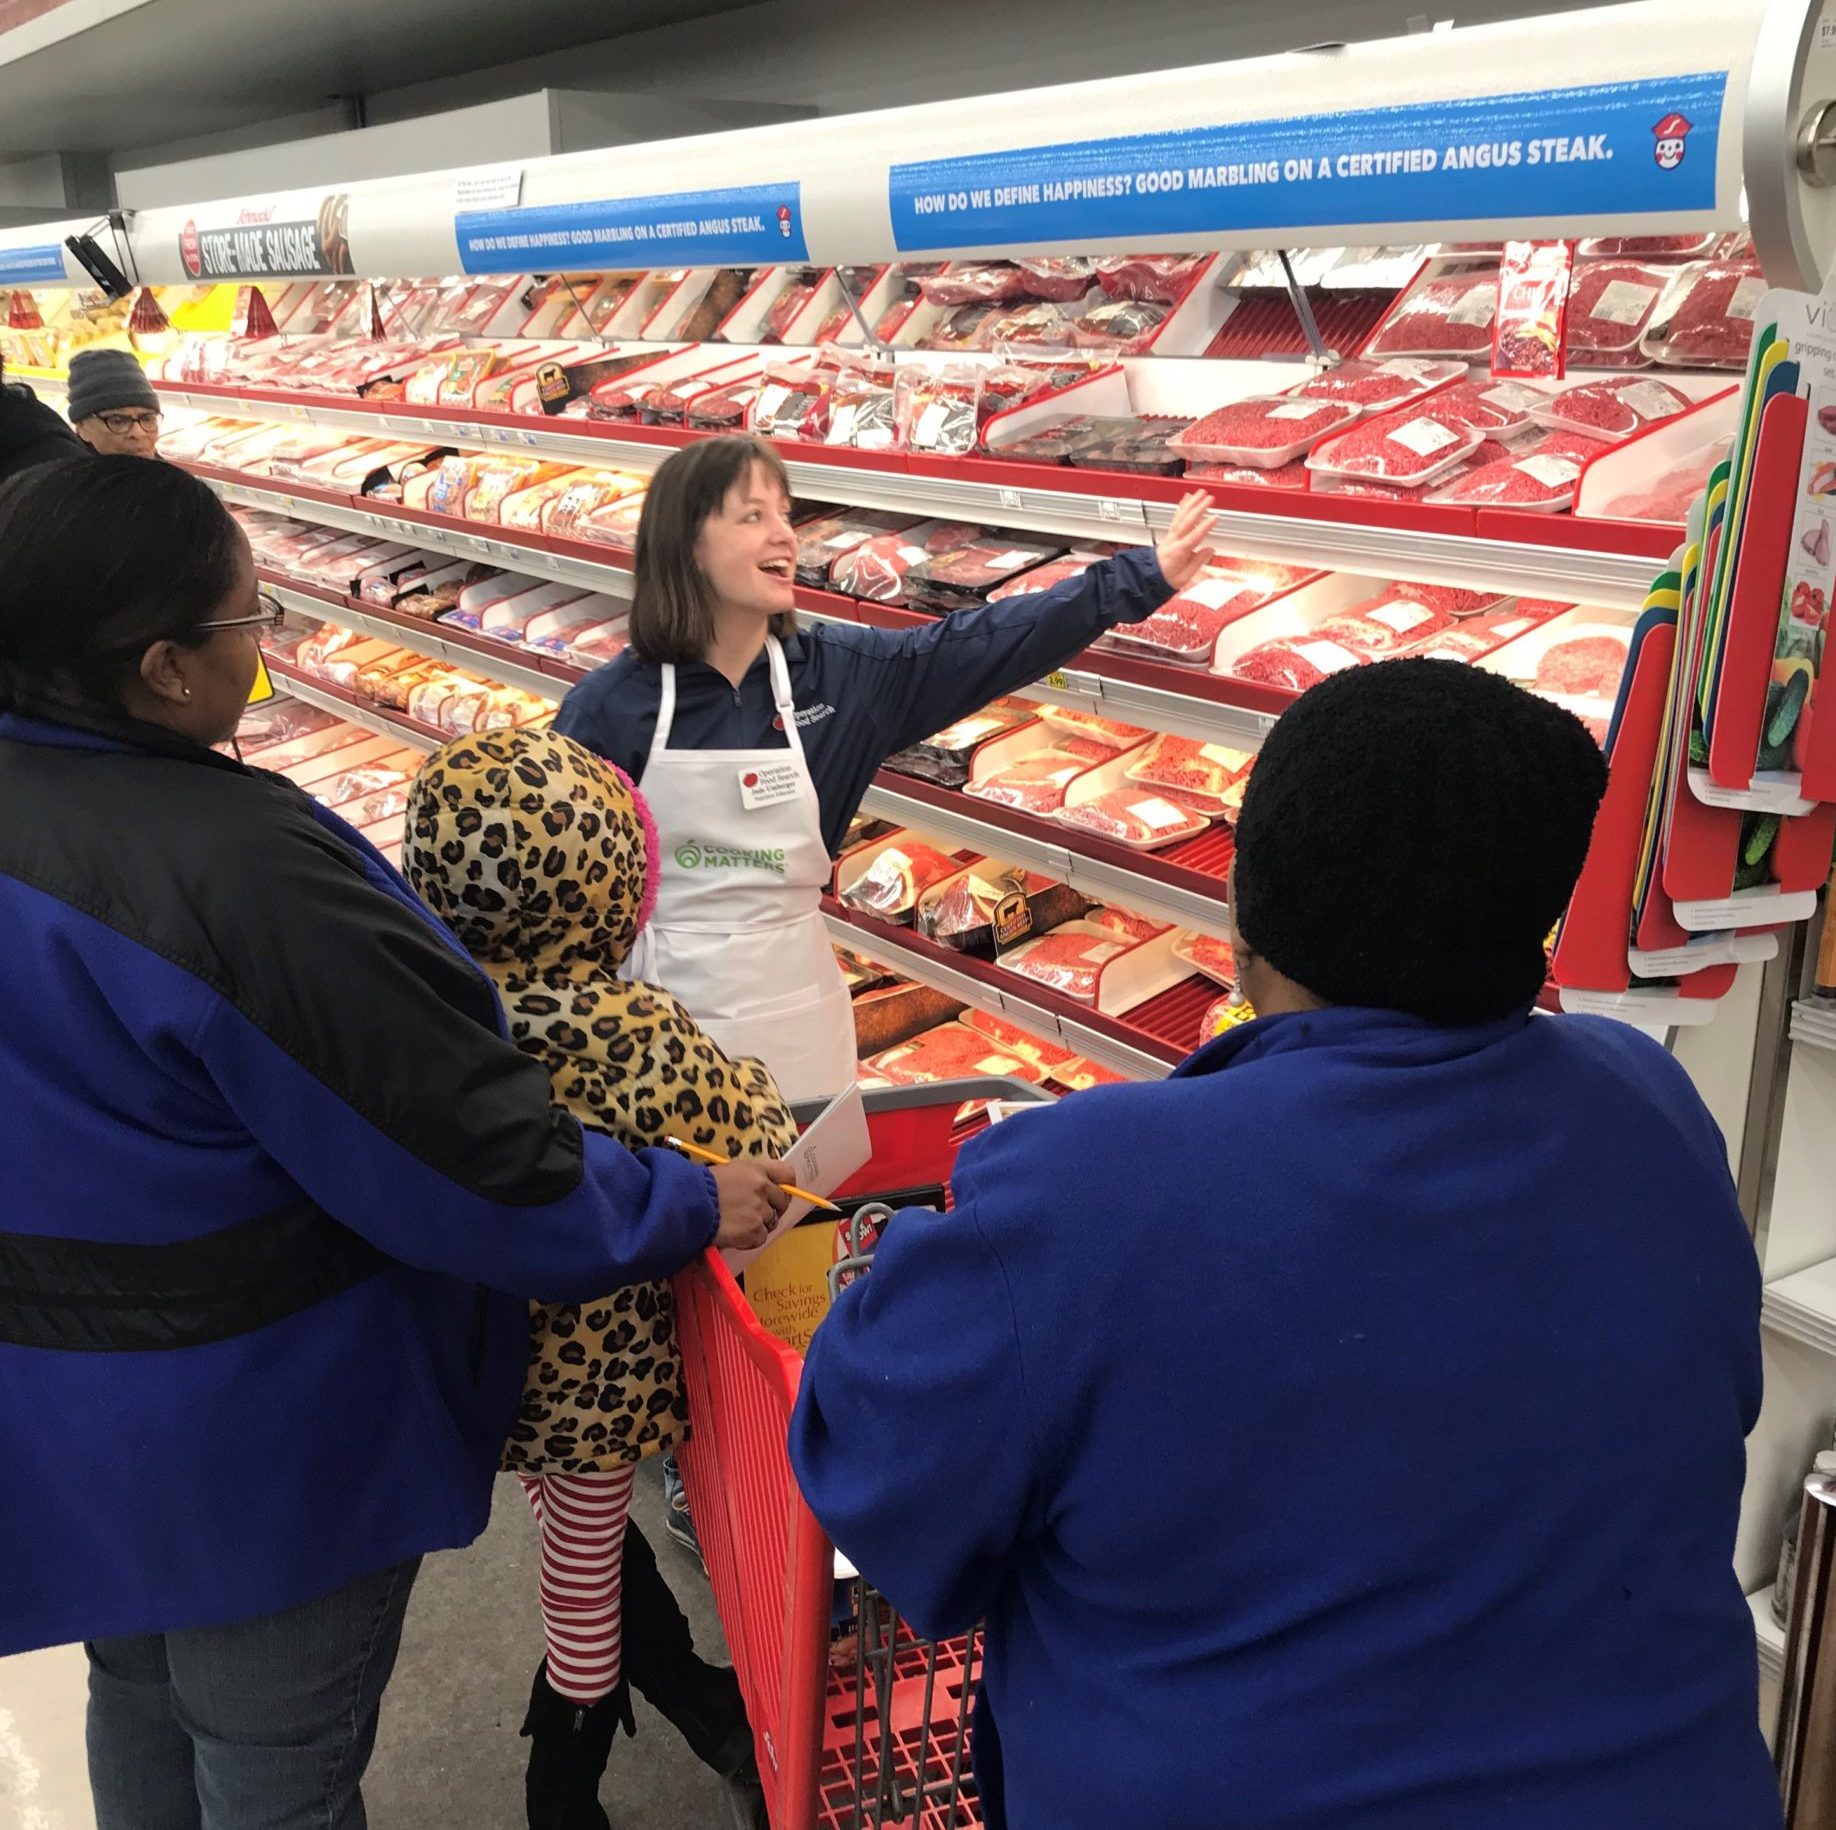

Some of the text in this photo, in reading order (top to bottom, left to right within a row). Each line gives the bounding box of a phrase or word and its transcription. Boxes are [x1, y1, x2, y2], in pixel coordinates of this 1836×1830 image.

[914, 134, 1614, 214] HOW DO WE DEFINE HAPPINESS? GOOD MARBLING ON A CERTIFIED ANGUS STEAK.
[469, 216, 766, 252] HOW DO WE DEFINE HAPPINESS? GOOD MARBLING ON A CERTIFIED ANGUS STEAK.
[201, 230, 268, 275] STORE-MADE
[266, 225, 321, 272] SAUSAGE
[1794, 342, 1832, 361] gripping
[792, 702, 826, 721] peration
[703, 845, 785, 862] COOKING
[703, 855, 785, 875] MATTERS
[753, 1282, 797, 1303] Check
[776, 1294, 826, 1313] Savings
[759, 1305, 819, 1328] torewide
